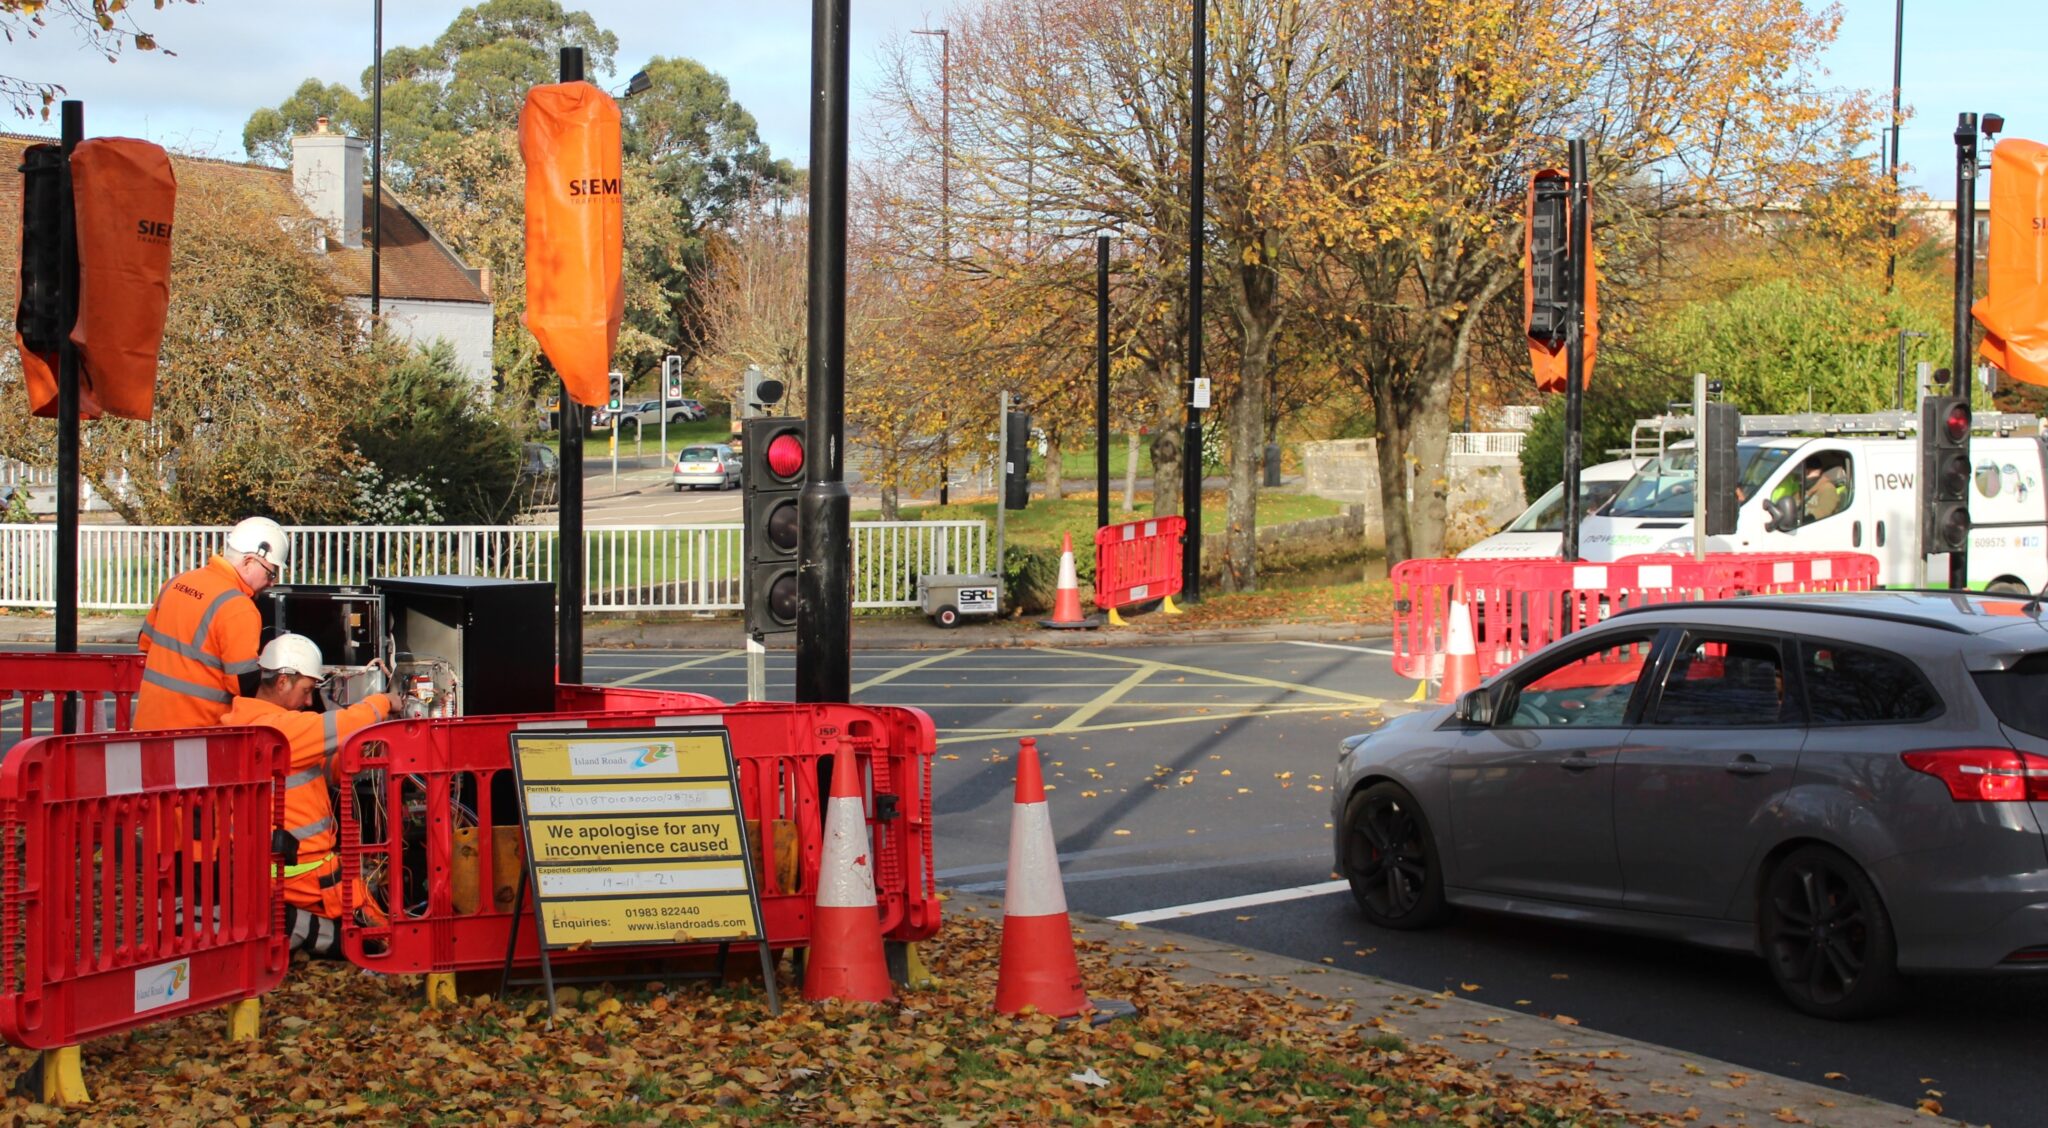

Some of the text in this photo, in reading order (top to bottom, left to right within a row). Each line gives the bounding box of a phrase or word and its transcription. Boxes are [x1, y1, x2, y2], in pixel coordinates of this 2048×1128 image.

[1975, 537, 2006, 548] 609575
[173, 582, 204, 600] SIEMENS
[960, 589, 995, 601] SRL
[574, 756, 628, 766] Island Roads
[547, 822, 721, 840] We apologise for any
[545, 838, 729, 857] inconvenience caused
[538, 867, 571, 875] Expected
[625, 906, 700, 918] 01983 822440
[552, 917, 611, 930] Enquiries:
[627, 917, 747, 931] www.islandroads.com
